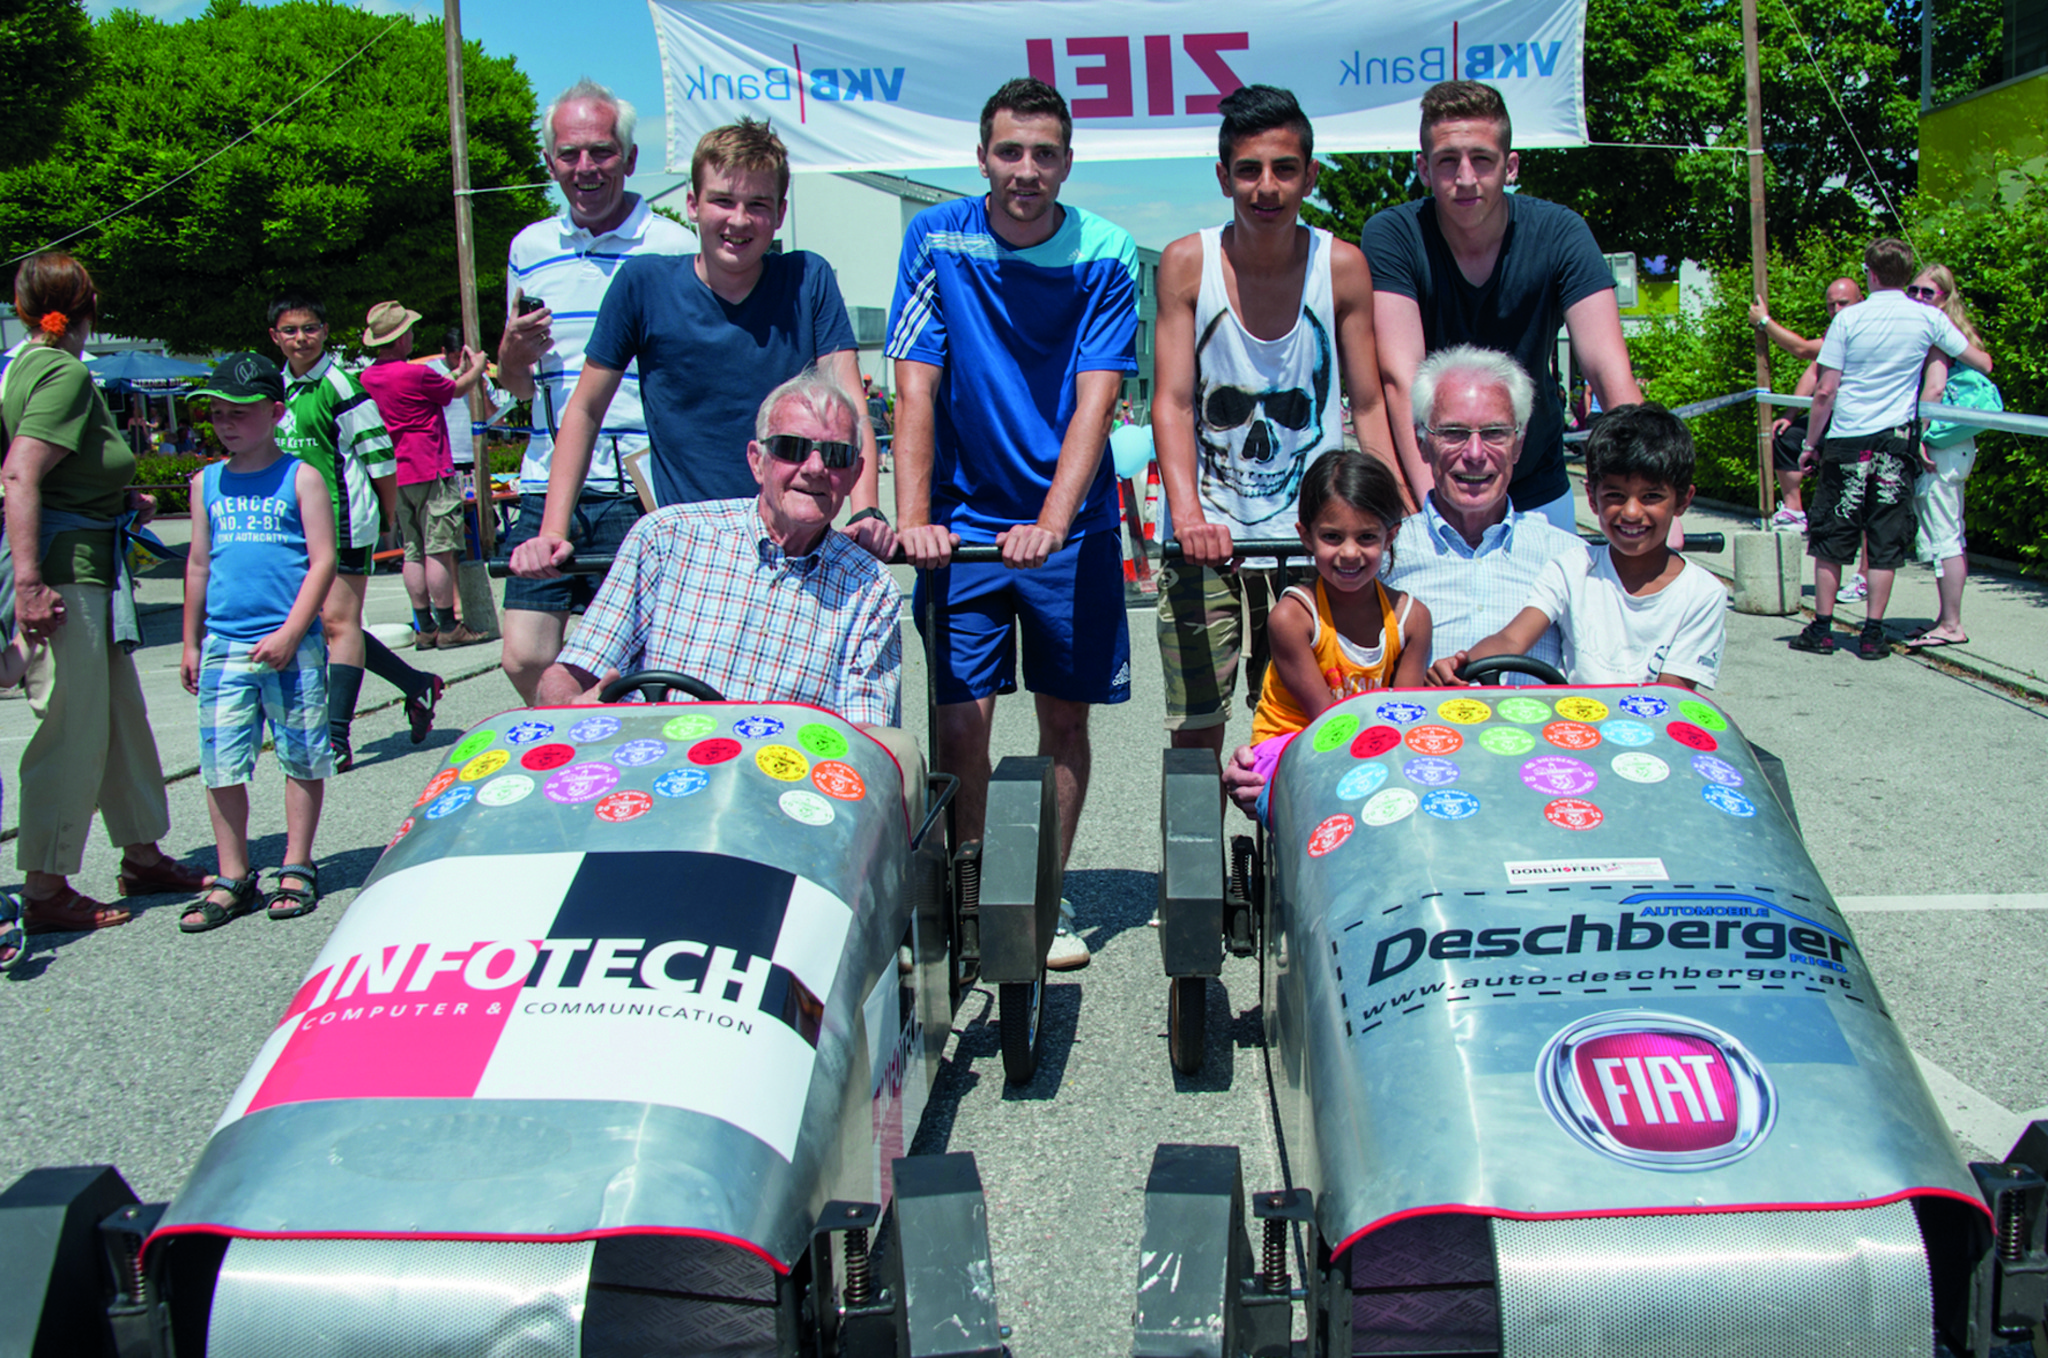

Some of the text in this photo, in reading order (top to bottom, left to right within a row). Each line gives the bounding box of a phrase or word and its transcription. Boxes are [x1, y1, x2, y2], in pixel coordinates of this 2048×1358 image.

[210, 495, 288, 518] MERCER
[218, 515, 282, 532] NO. 2-81
[235, 532, 289, 544] AUTHORITY
[1640, 906, 1770, 918] AUTOMOBILE
[1367, 912, 1850, 987] Deschberger
[1788, 953, 1848, 975] RIED
[306, 938, 772, 1013] INFOTECH
[1363, 965, 1852, 1021] www.auto-deschberger.at
[301, 1001, 754, 1036] COMPUTER & COMMUNICATION
[1592, 1054, 1726, 1127] FIAT
